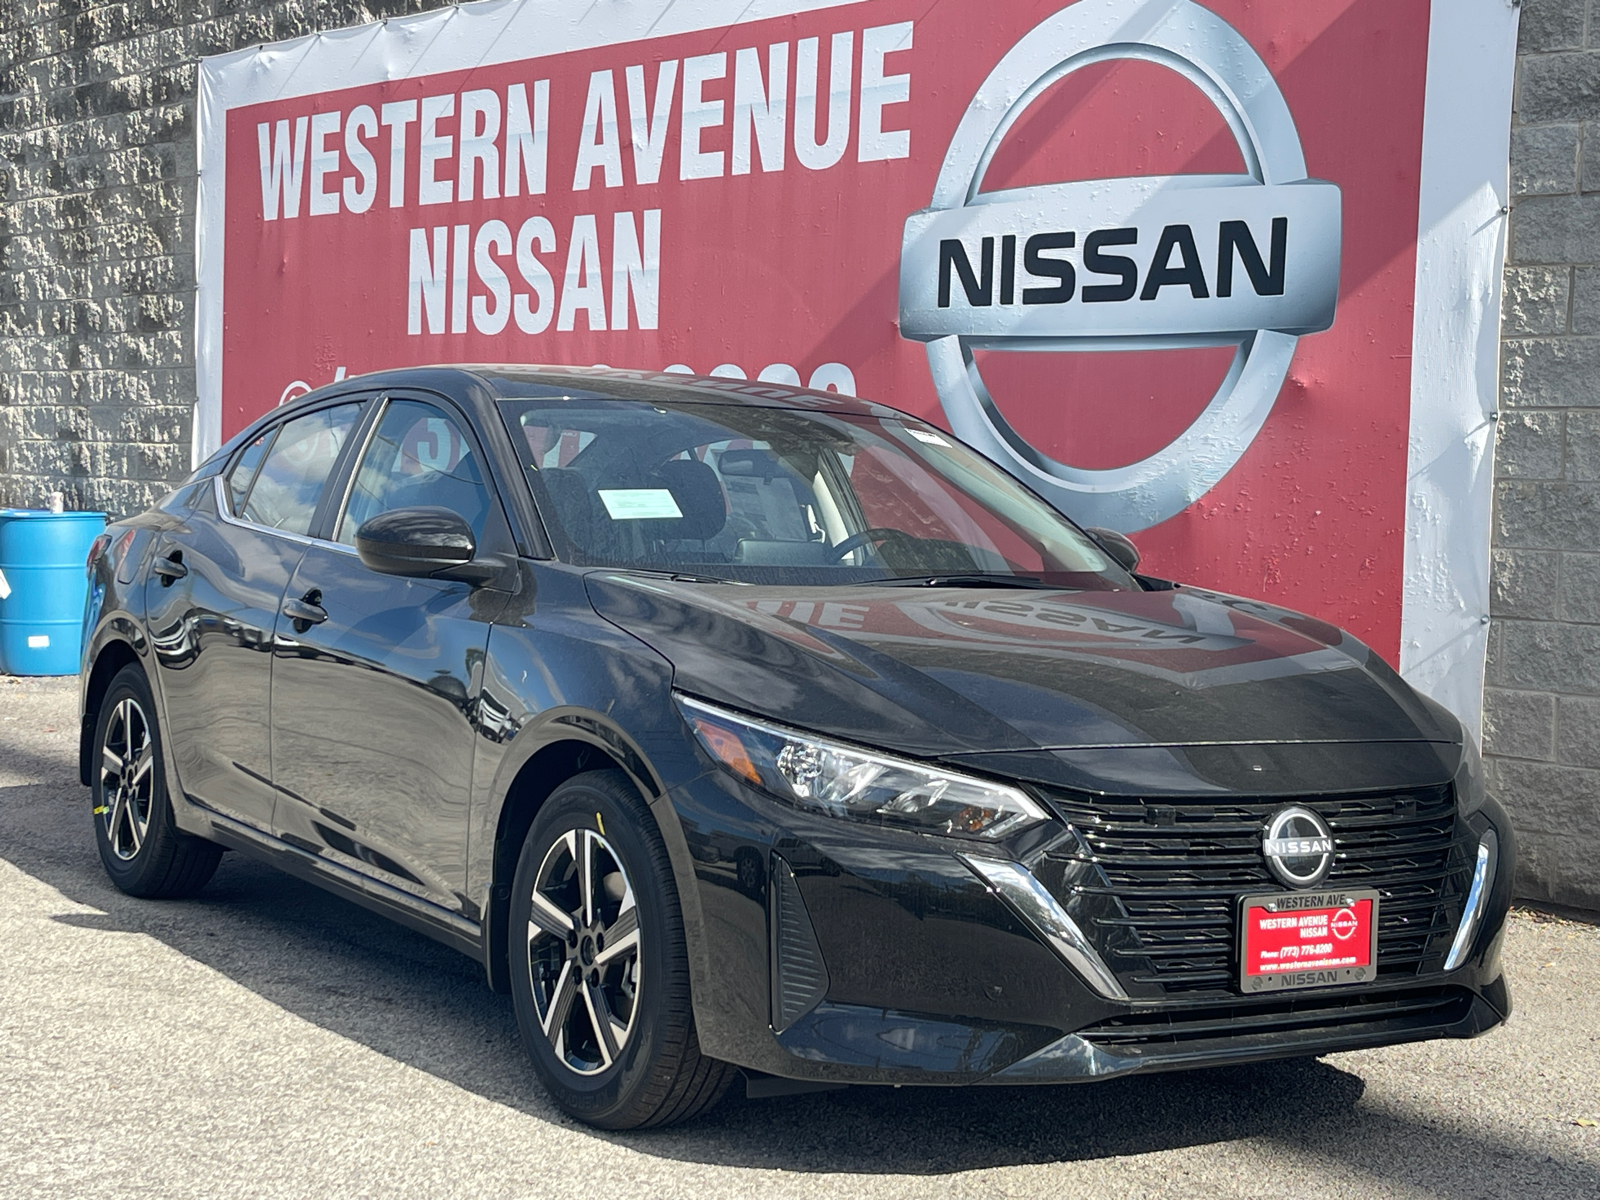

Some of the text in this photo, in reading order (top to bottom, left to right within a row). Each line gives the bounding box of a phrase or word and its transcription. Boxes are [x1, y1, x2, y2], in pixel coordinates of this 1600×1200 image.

[256, 21, 915, 222] WESTERN AVENUE
[937, 217, 1288, 308] NISSAN
[407, 208, 662, 337] NISSAN
[1267, 840, 1332, 854] NISSAN
[1276, 895, 1325, 910] WESTERN
[1260, 915, 1328, 930] WESTERN AVENUE
[1330, 920, 1358, 928] NISSAN
[1300, 926, 1328, 939] NISSAN
[1280, 945, 1300, 959] (773)
[1281, 970, 1338, 987] NISSAN
